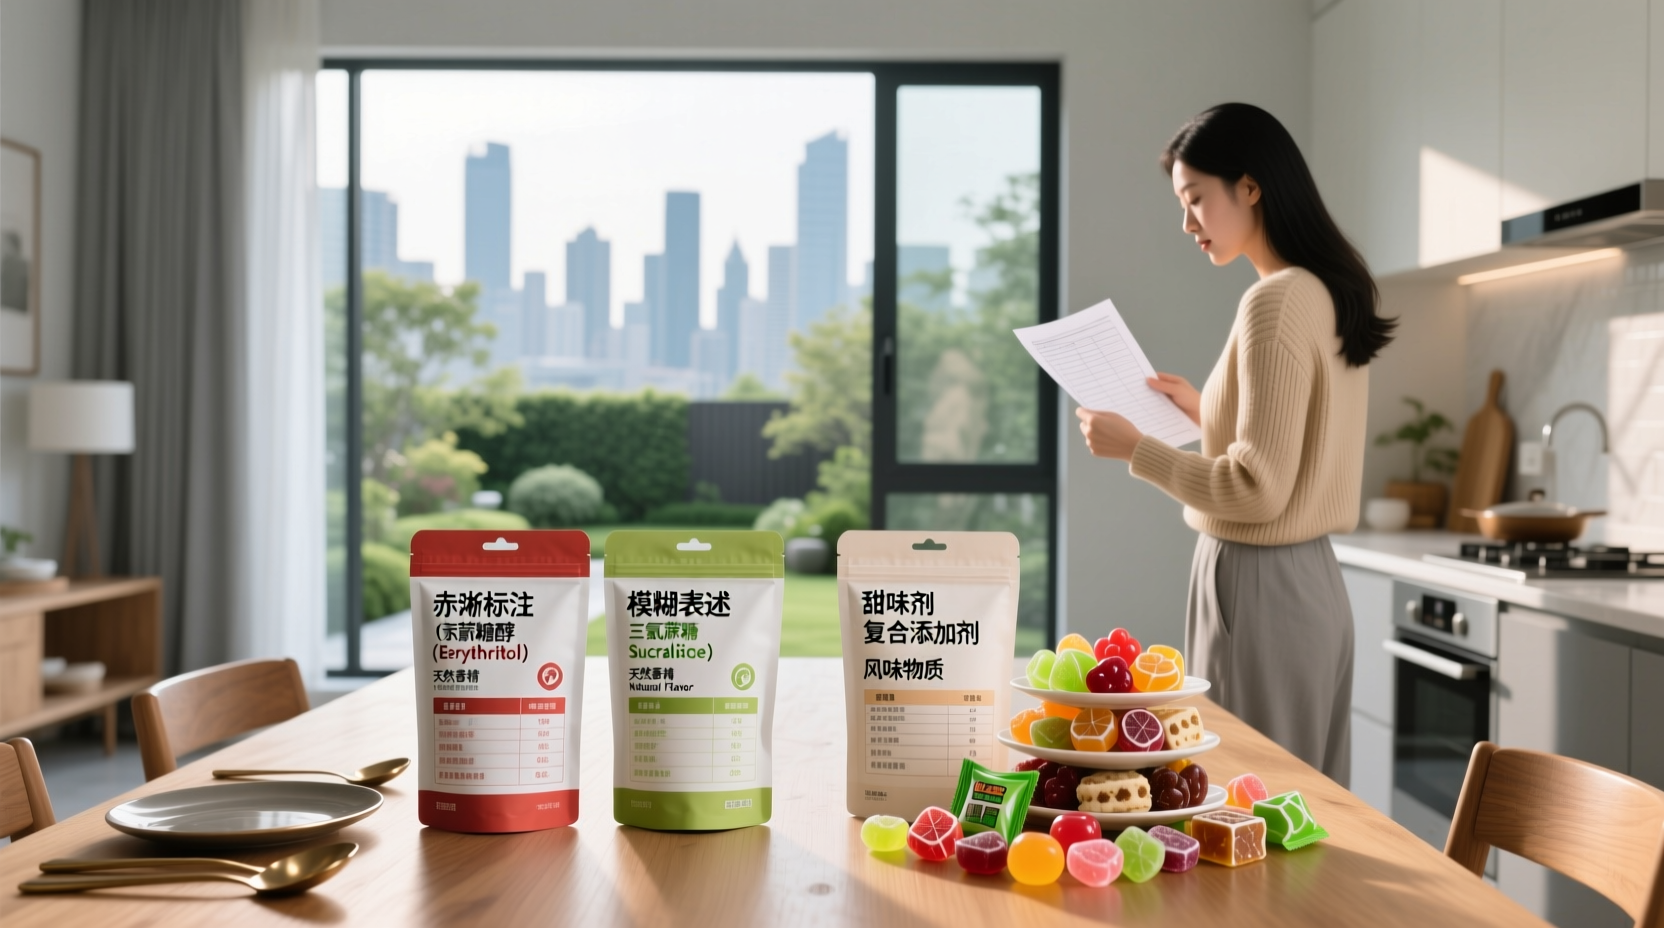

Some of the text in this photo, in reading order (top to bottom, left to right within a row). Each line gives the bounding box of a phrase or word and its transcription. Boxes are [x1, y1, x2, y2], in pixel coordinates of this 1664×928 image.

[626, 589, 731, 618] 模糊表述
[861, 589, 934, 616] 甜味剂
[863, 619, 980, 646] 复合添加剂
[864, 658, 944, 681] 风味物质
